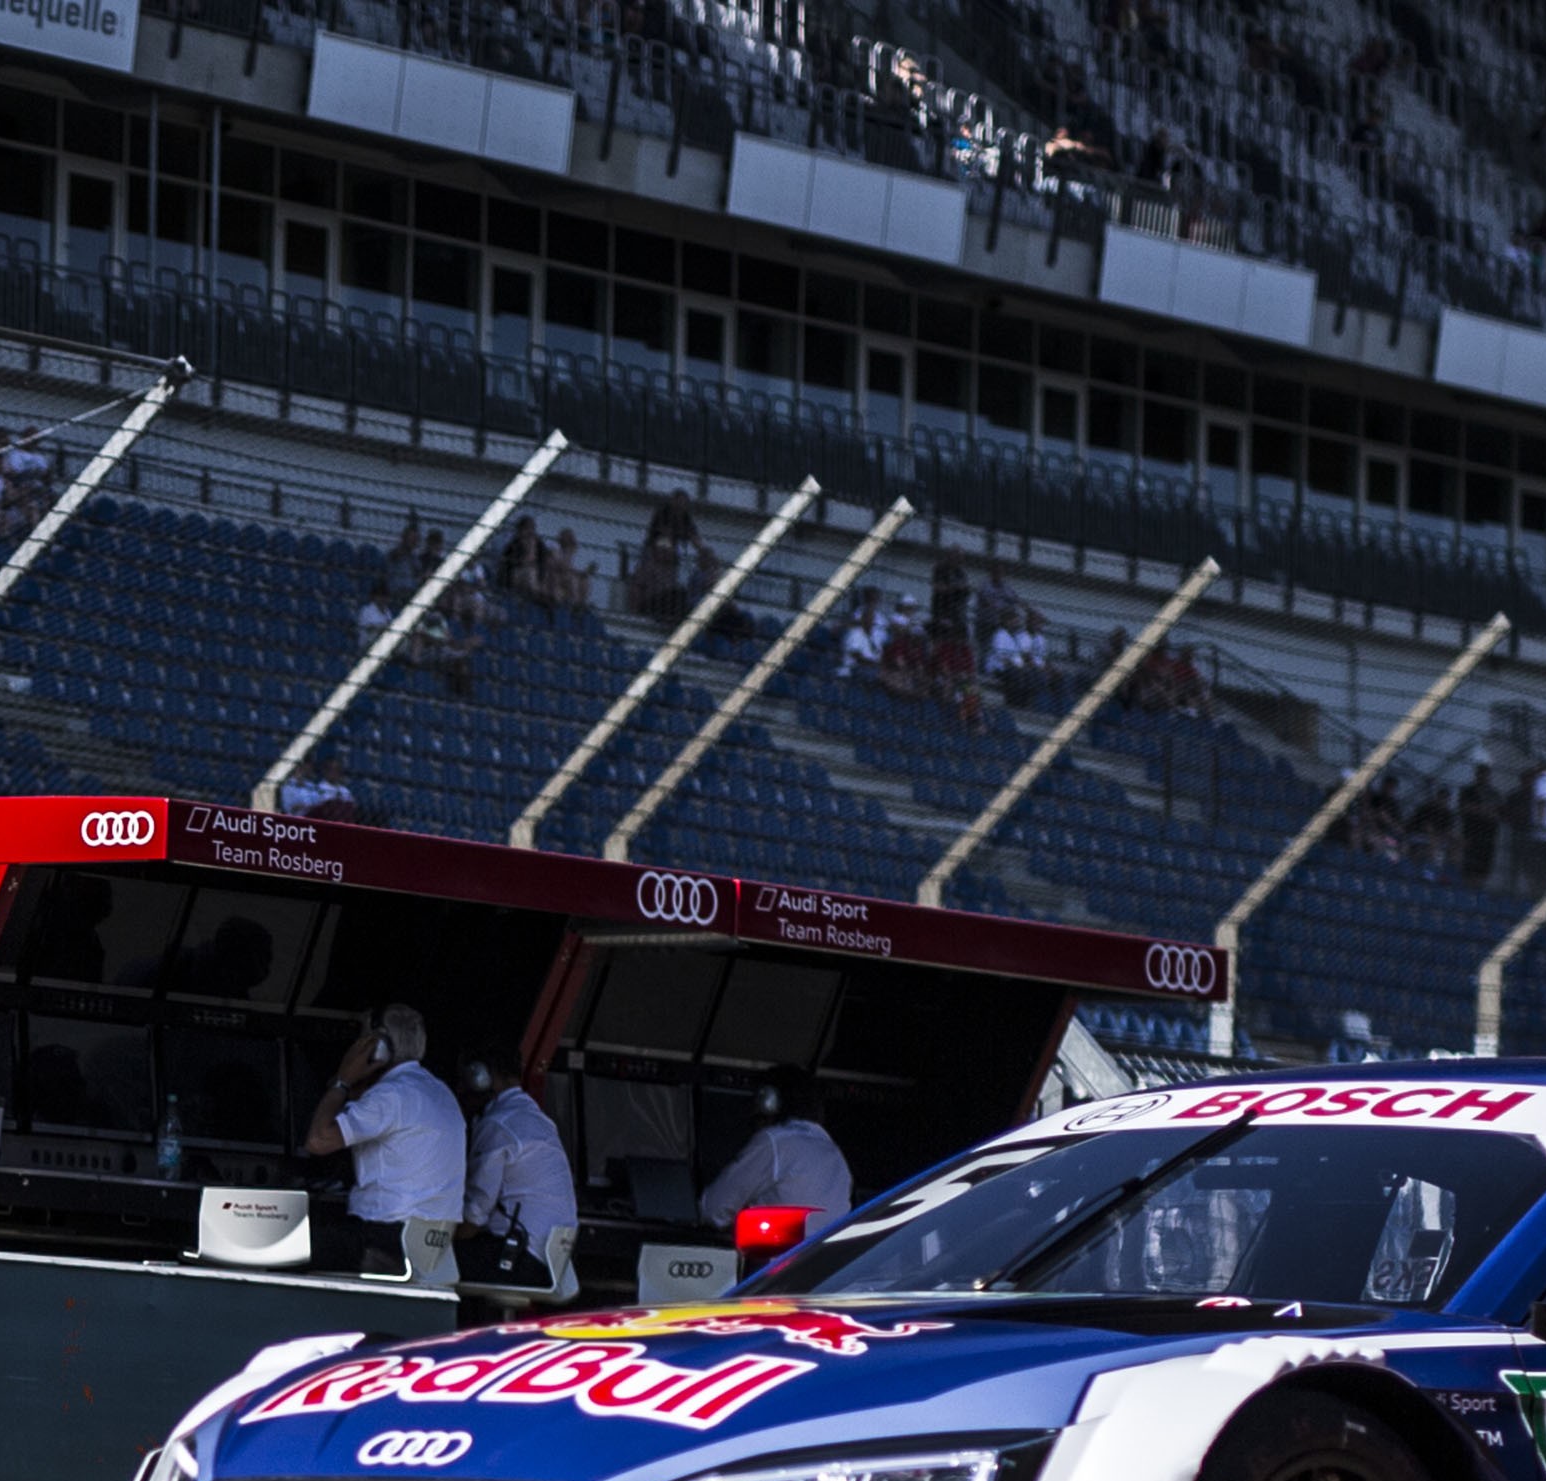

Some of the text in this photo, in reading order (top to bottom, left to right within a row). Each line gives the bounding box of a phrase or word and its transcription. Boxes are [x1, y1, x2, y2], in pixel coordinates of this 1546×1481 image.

[212, 810, 317, 843] Audi Sport
[211, 840, 344, 883] Team Rosberg
[778, 890, 870, 921] Audi Sport
[777, 917, 892, 957] Team Rosberg
[1170, 1086, 1536, 1122] BOSCH
[240, 1340, 818, 1429] Red Bull
[1450, 1393, 1497, 1416] Sport
